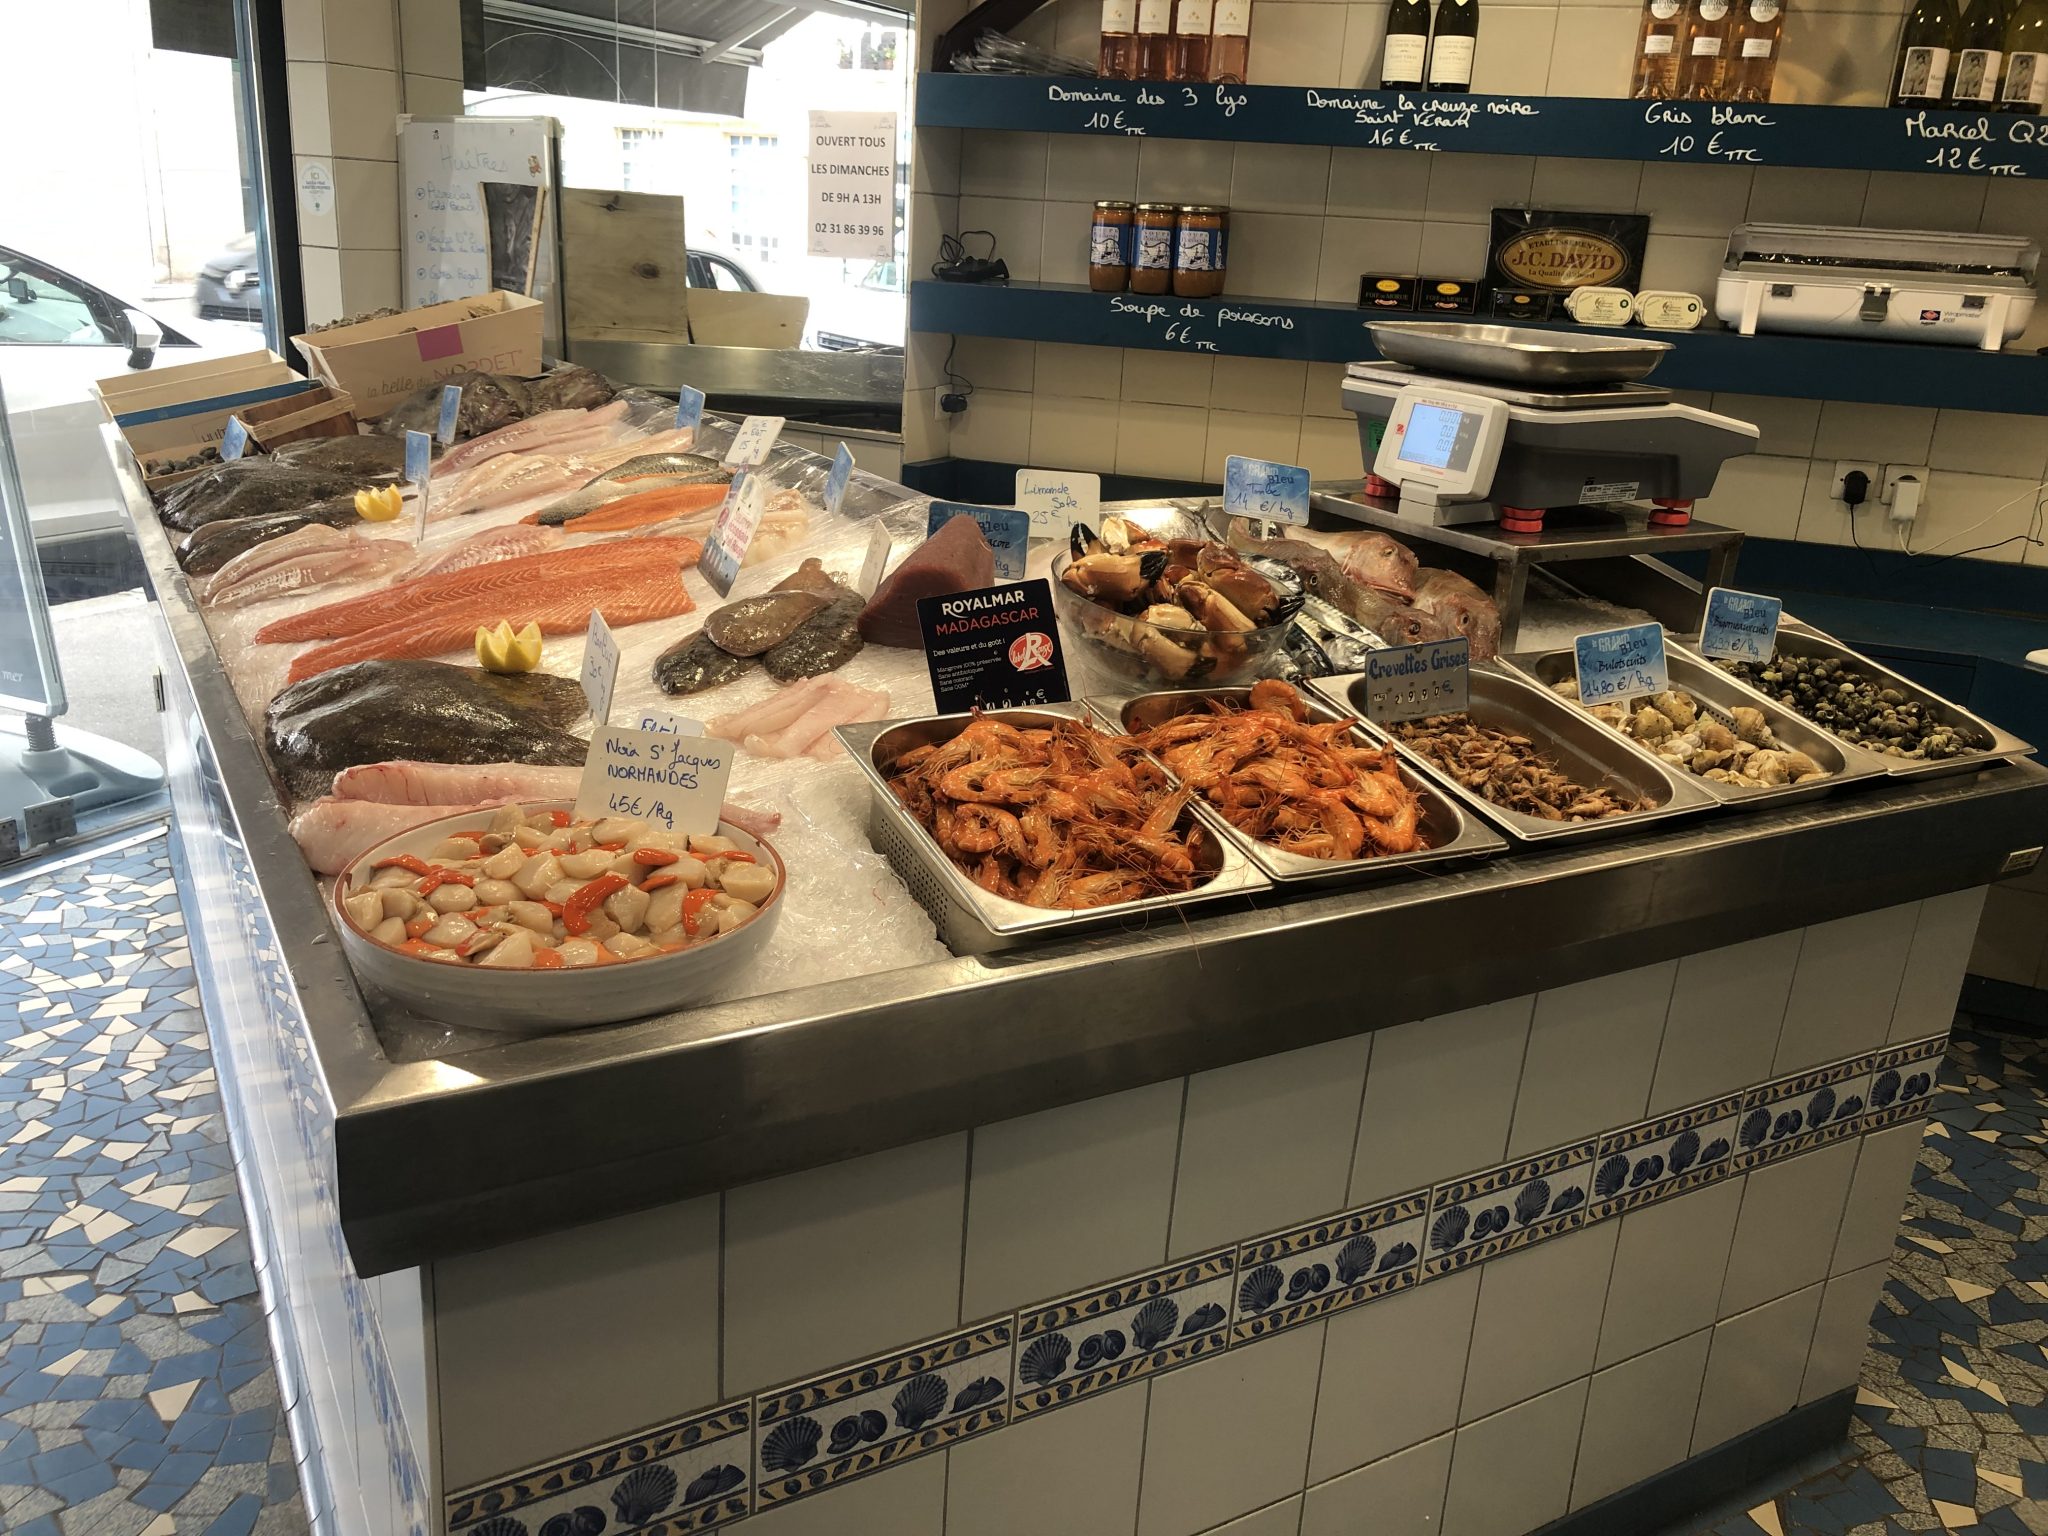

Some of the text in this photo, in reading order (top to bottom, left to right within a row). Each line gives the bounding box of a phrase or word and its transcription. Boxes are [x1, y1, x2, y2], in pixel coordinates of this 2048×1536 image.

[1048, 85, 1248, 117] Domaine des 3 lys
[1307, 89, 1385, 109] Domaine
[1398, 93, 1417, 110] la
[1354, 109, 1404, 124] Saint
[1645, 102, 1777, 125] Gris blanc
[1125, 126, 1147, 136] TTC
[1905, 110, 1996, 141] Marcel
[816, 135, 886, 148] OUVERT TOUS
[1413, 143, 1442, 152] TTC
[1660, 135, 1694, 155] 10
[1724, 149, 1763, 161] TTC
[811, 163, 890, 177] LES DIMANCHES
[1988, 164, 2027, 176] TTC
[821, 192, 881, 205] DE 9H A 13H
[815, 222, 884, 236] 02 31 86 39 96
[1512, 250, 1615, 270] J.C. DAVID
[1110, 297, 1294, 330] Soupe de poissons
[1195, 341, 1220, 352] TTC
[382, 378, 413, 396] belle
[1267, 474, 1295, 485] Bleu
[1052, 497, 1078, 510] Sole
[941, 590, 1025, 619] ROYALMAR
[1743, 608, 1767, 619] Bleu
[936, 607, 1039, 637] MADAGASCAR
[933, 649, 946, 657] Des
[946, 645, 970, 654] valeurs
[1598, 633, 1630, 652] GRAND
[1619, 638, 1649, 656] Bleu
[1369, 648, 1468, 680] Crevettes Grises
[669, 738, 721, 775] Jacques
[607, 764, 699, 790] NORMANDES
